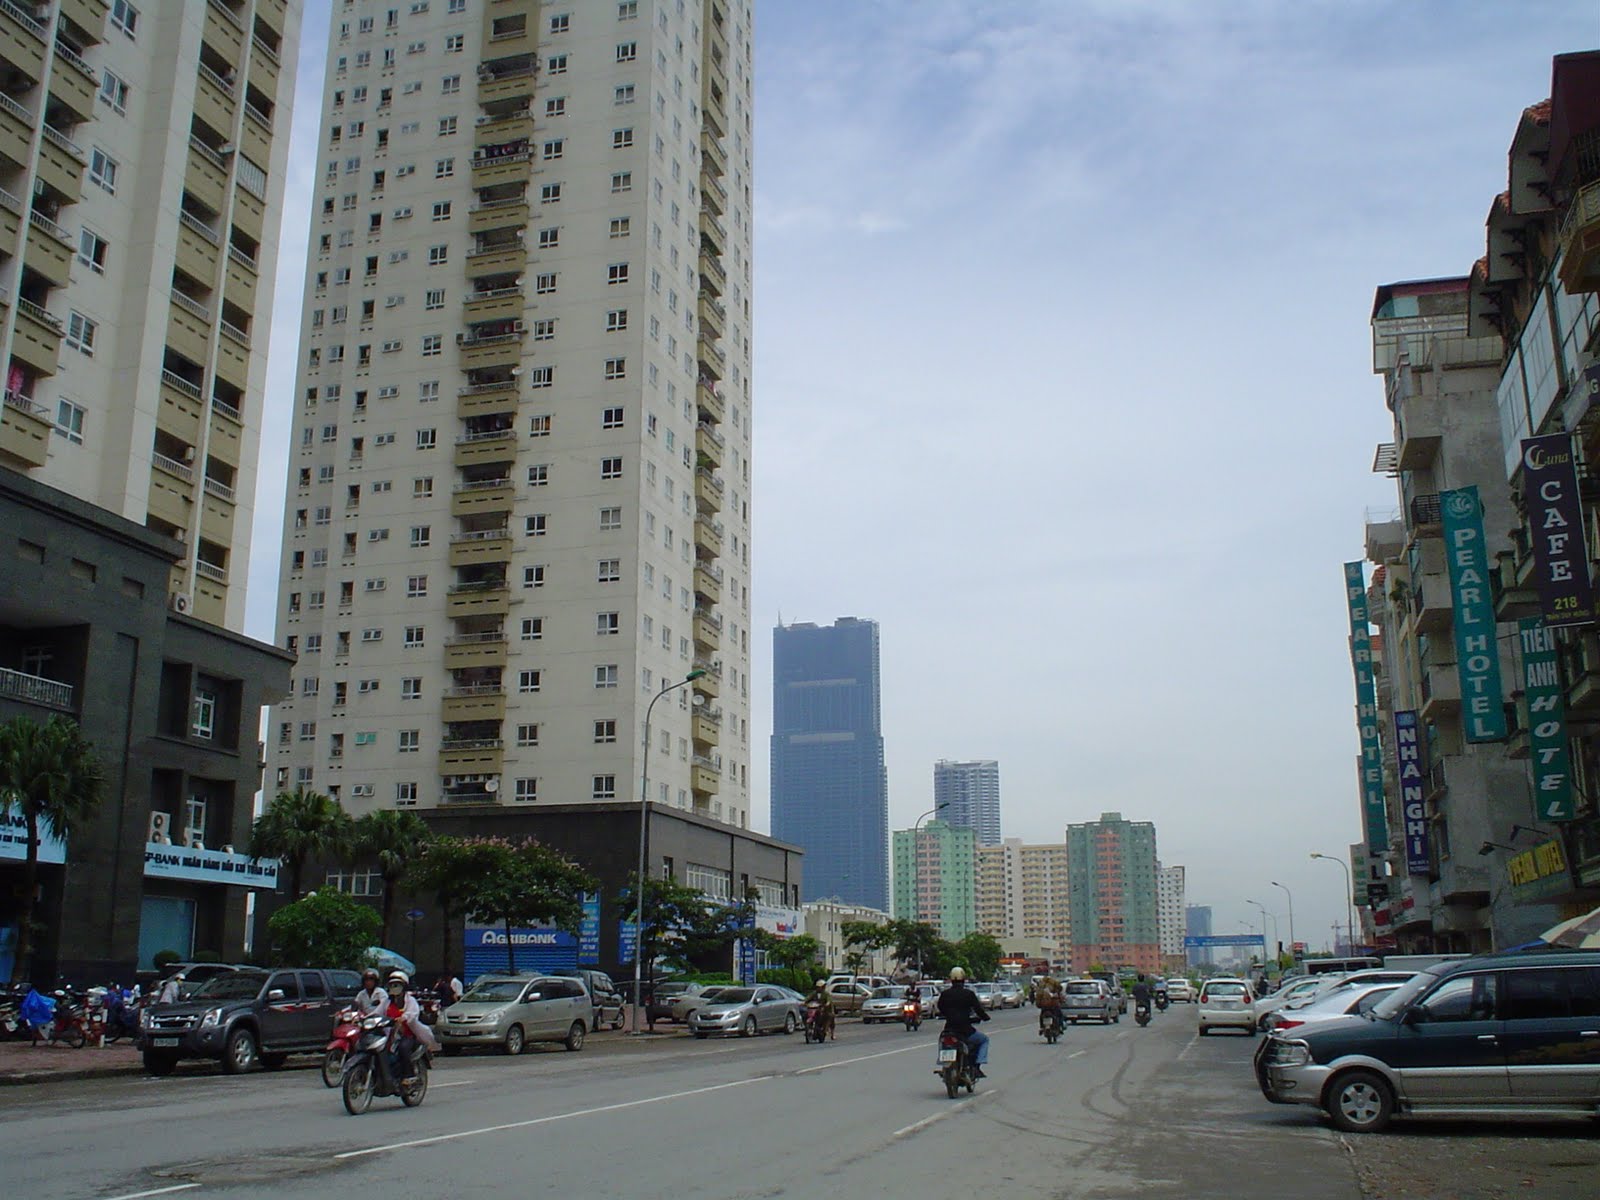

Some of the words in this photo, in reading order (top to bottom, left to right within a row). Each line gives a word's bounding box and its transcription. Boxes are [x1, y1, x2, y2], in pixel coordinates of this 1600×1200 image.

[1531, 449, 1569, 469] Luna
[1455, 529, 1482, 624] PEARL
[1540, 480, 1573, 582] CAFE
[1350, 587, 1371, 684] PEARL
[1554, 596, 1578, 610] 218
[1465, 634, 1495, 738] HOTEL
[1527, 661, 1558, 687] ANH
[1360, 703, 1381, 804] HOTEL
[1398, 727, 1422, 778] NHÀ
[1530, 694, 1565, 817] HOTEL
[481, 930, 557, 944] AGRIBANK
